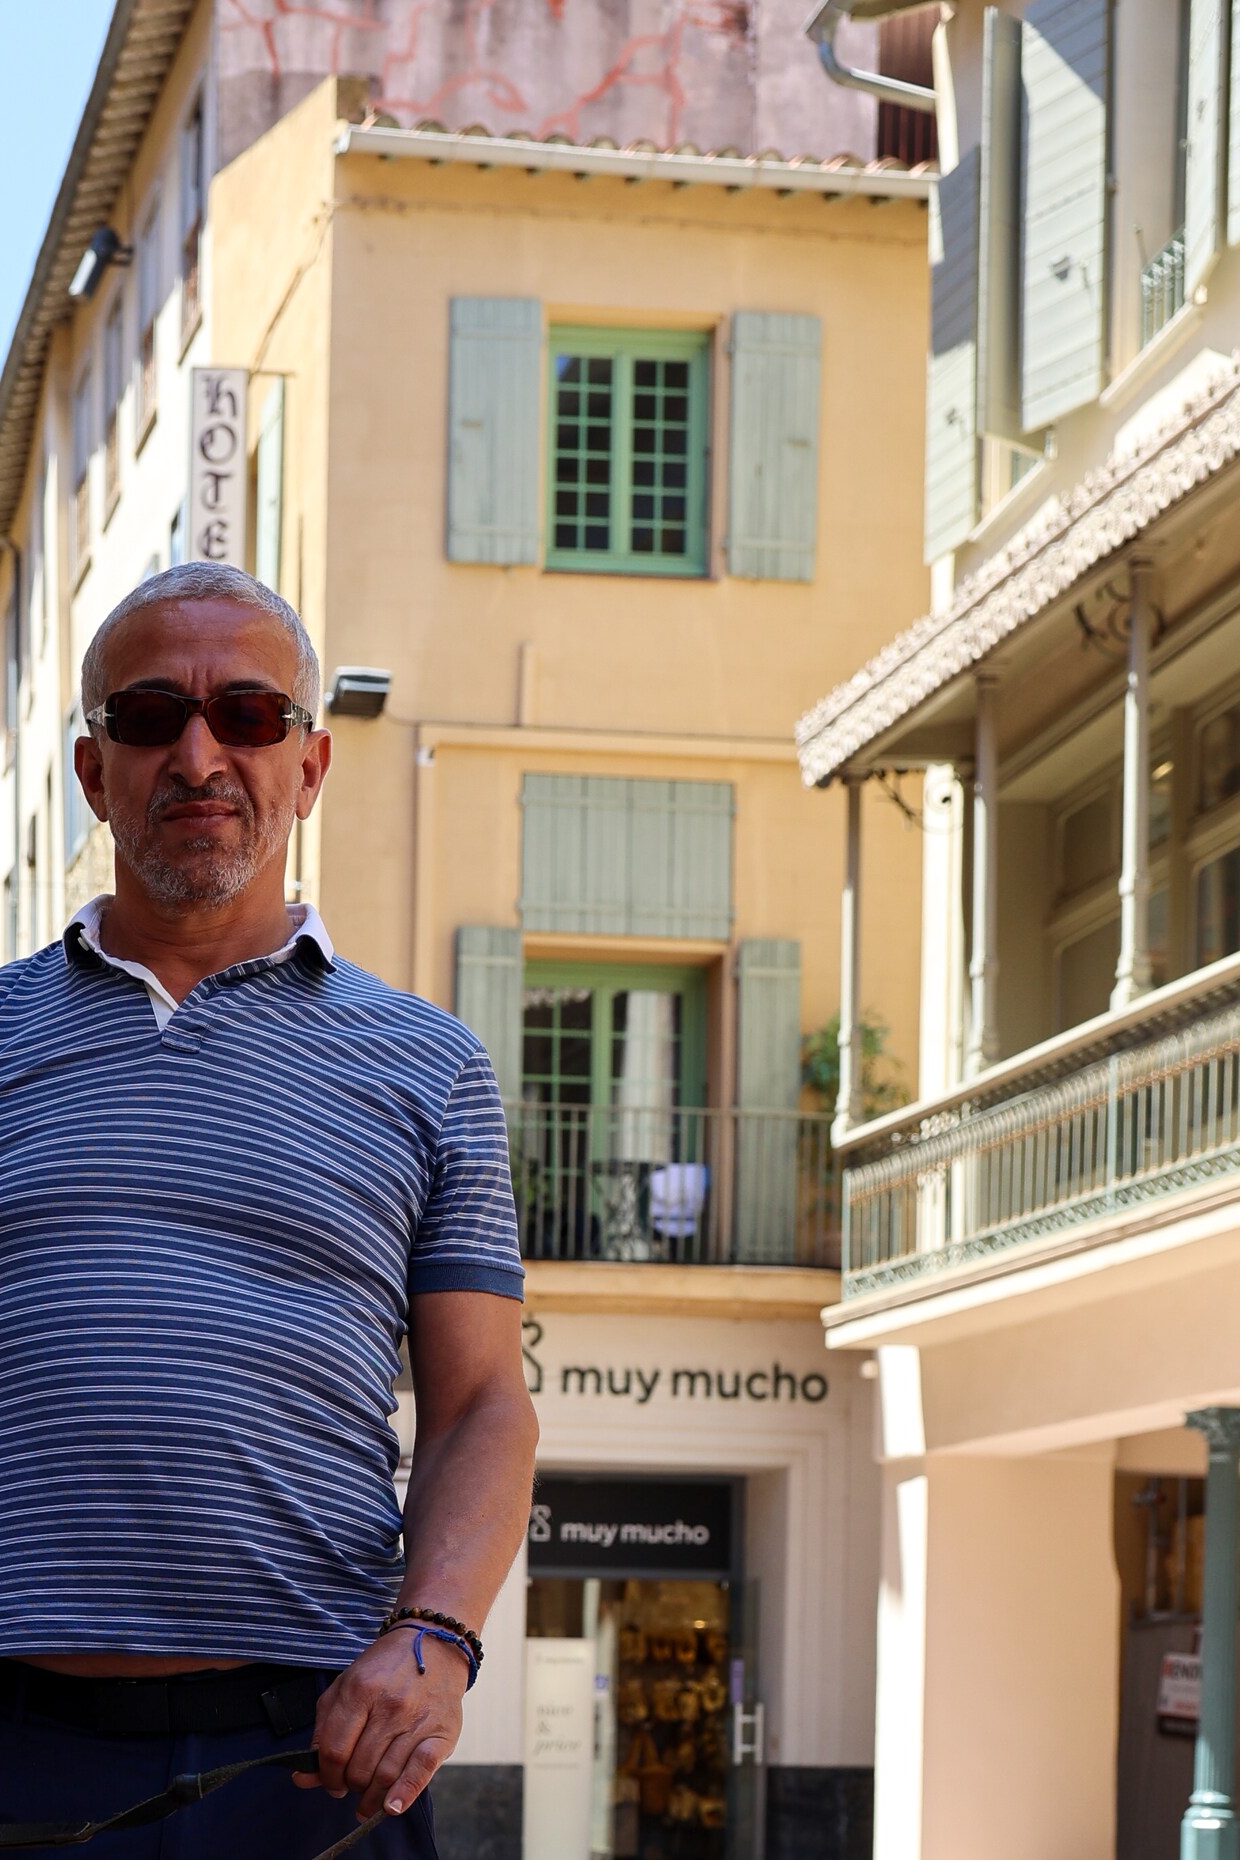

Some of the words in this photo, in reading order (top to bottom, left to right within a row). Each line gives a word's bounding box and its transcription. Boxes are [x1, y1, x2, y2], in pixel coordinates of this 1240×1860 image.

[199, 373, 238, 560] HOTE
[561, 1365, 659, 1404] muy
[672, 1361, 829, 1402] mucho
[560, 1521, 619, 1548] muy
[620, 1518, 710, 1545] mucho
